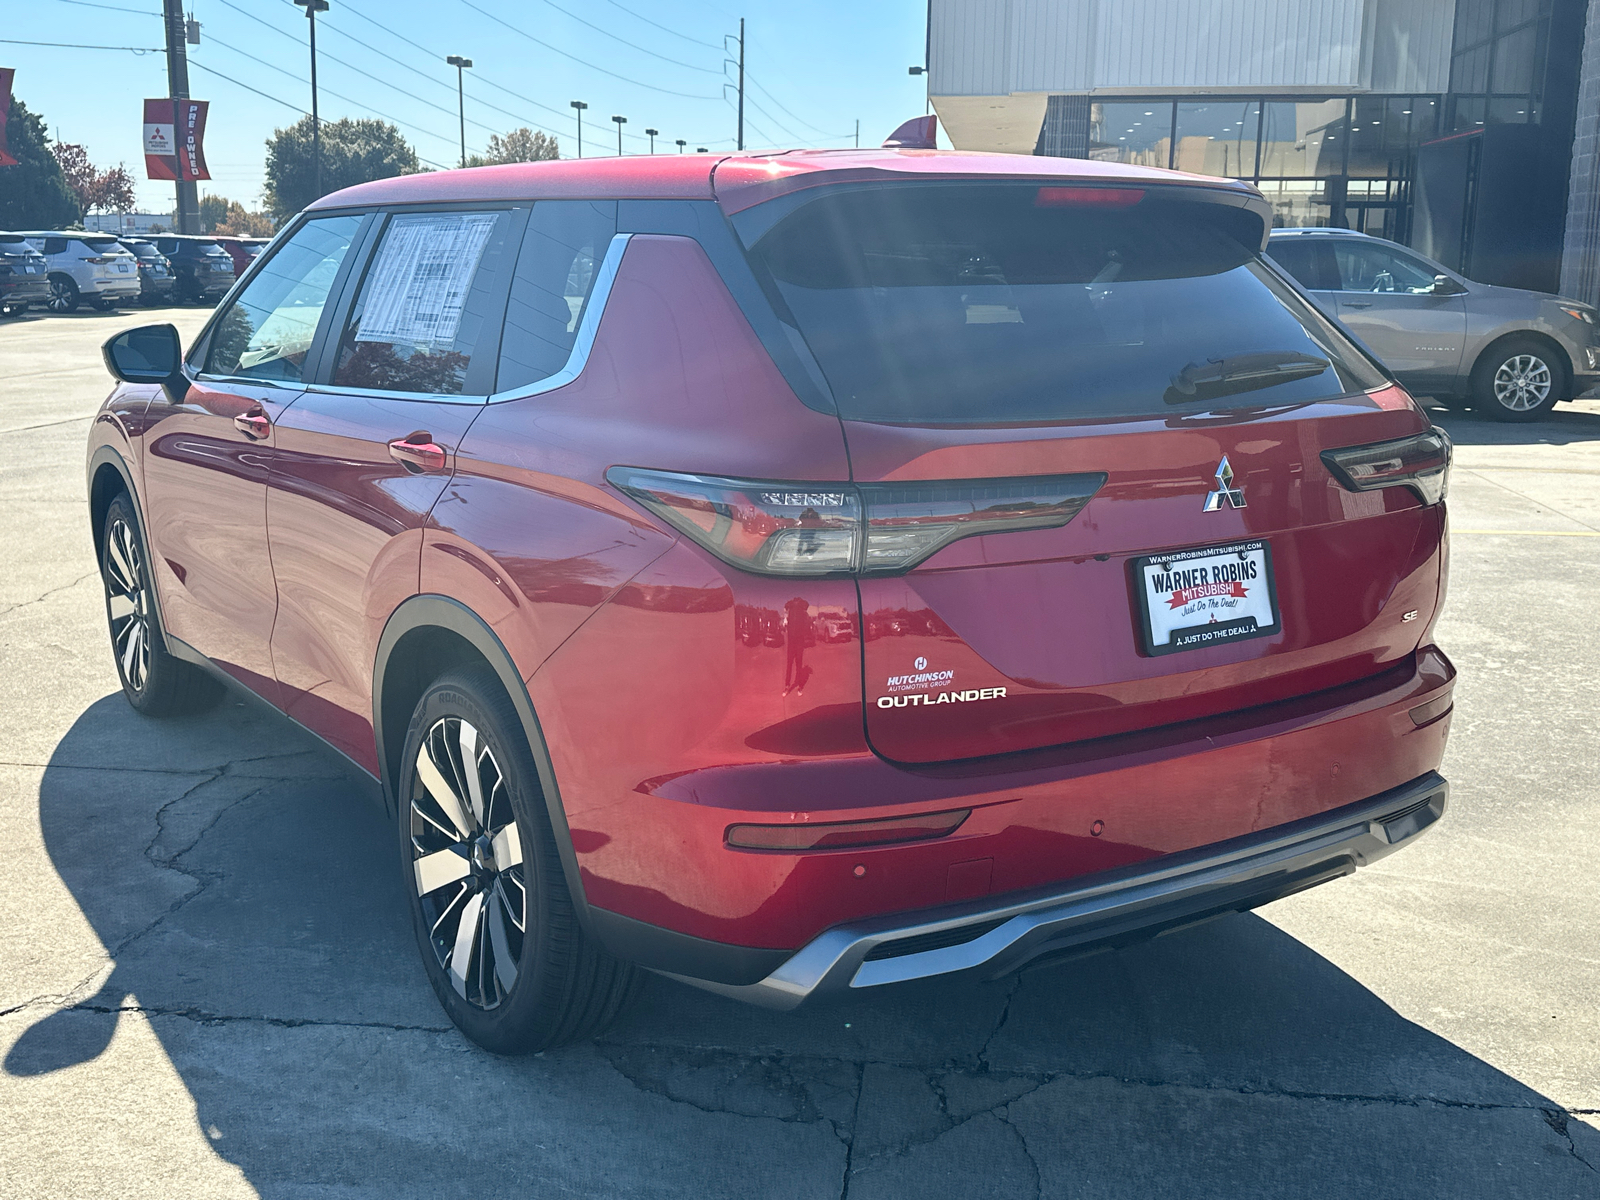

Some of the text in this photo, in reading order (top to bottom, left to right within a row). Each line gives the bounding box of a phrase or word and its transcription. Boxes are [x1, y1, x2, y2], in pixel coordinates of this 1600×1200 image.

[186, 105, 200, 176] PRE-OWNED
[1151, 560, 1257, 594] WARNER ROBINS
[1181, 583, 1235, 601] MITSUBISHI
[1181, 603, 1196, 617] Just
[1197, 600, 1206, 612] Do
[1208, 598, 1220, 609] The
[1401, 609, 1418, 623] SE
[1183, 625, 1249, 645] JUST DO THE DEAL!
[887, 670, 954, 686] HUTCHINSON
[888, 679, 951, 692] AUTOMOTIVE GROUP
[877, 686, 1007, 709] OUTLANDER
